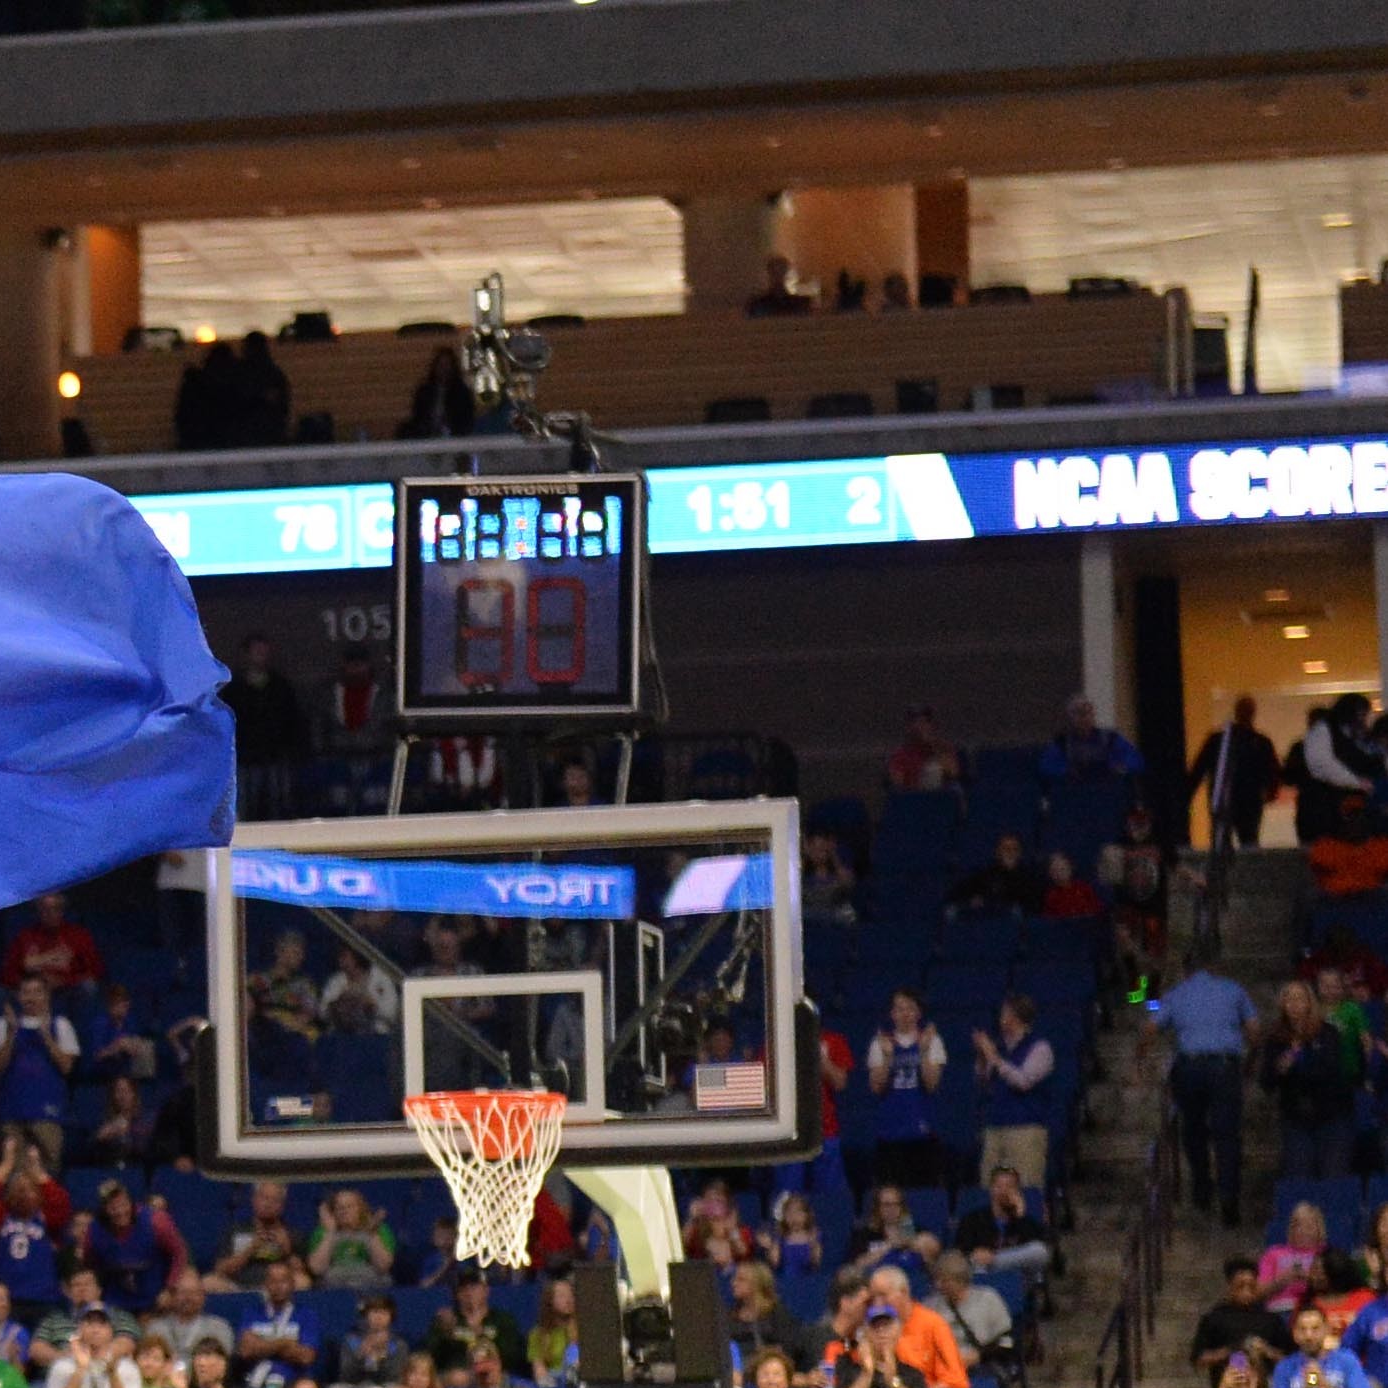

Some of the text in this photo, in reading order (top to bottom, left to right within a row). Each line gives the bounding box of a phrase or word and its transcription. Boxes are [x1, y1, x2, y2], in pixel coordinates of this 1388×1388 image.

[466, 484, 579, 496] DAKTRONICS
[1014, 453, 1180, 531] NCAA
[325, 604, 391, 642] 105
